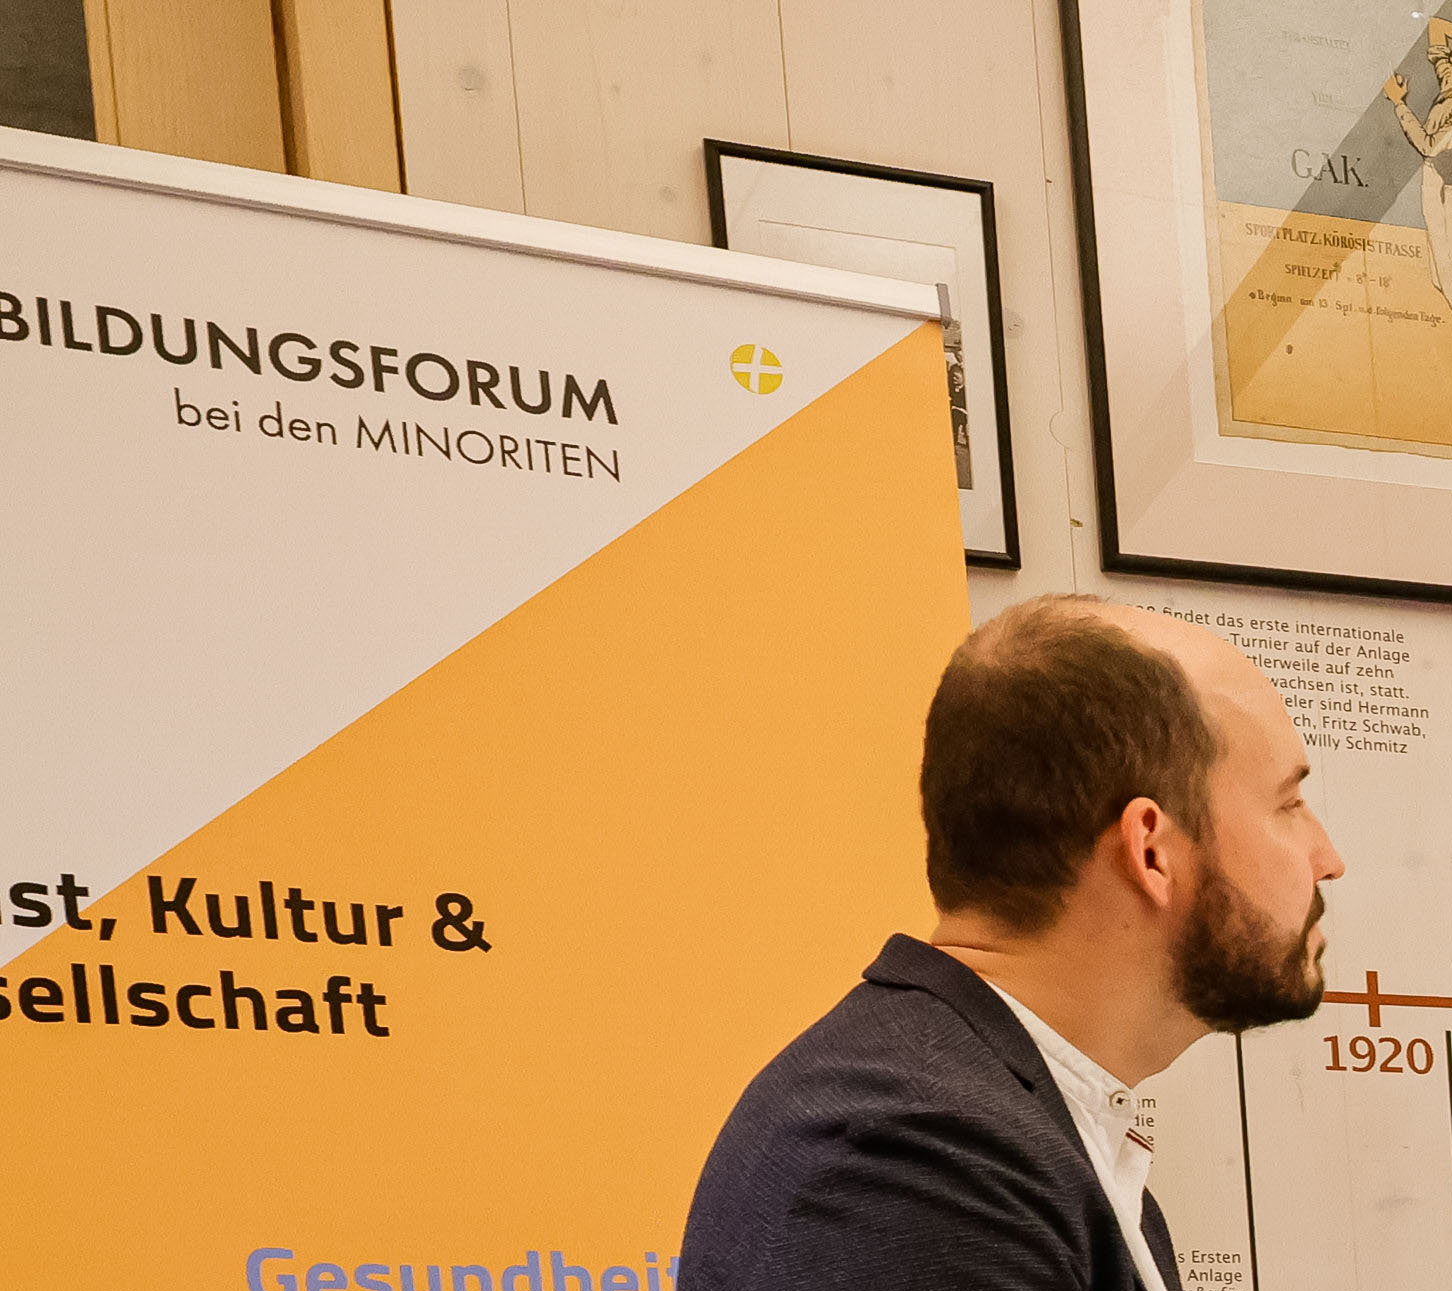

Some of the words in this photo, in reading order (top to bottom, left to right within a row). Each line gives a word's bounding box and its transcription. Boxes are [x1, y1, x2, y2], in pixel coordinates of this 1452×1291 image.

[0, 291, 618, 425] BILDUNGSFORUM
[174, 387, 241, 432] bei
[258, 401, 338, 445] den
[357, 415, 620, 481] MINORITEN
[1216, 611, 1243, 628] das
[1250, 618, 1289, 632] erste
[1296, 619, 1404, 643] internationale
[1319, 697, 1351, 713] sind
[1358, 699, 1428, 718] Hermann
[1322, 714, 1356, 731] Fritz
[1362, 717, 1425, 739] Schwab,
[1303, 731, 1339, 752] Willy
[1346, 734, 1407, 753] Schmitz
[0, 873, 117, 940] st,
[147, 875, 404, 946] Kultur
[431, 892, 493, 953] &
[0, 963, 390, 1037] sellschaft
[1323, 1035, 1434, 1074] 1920
